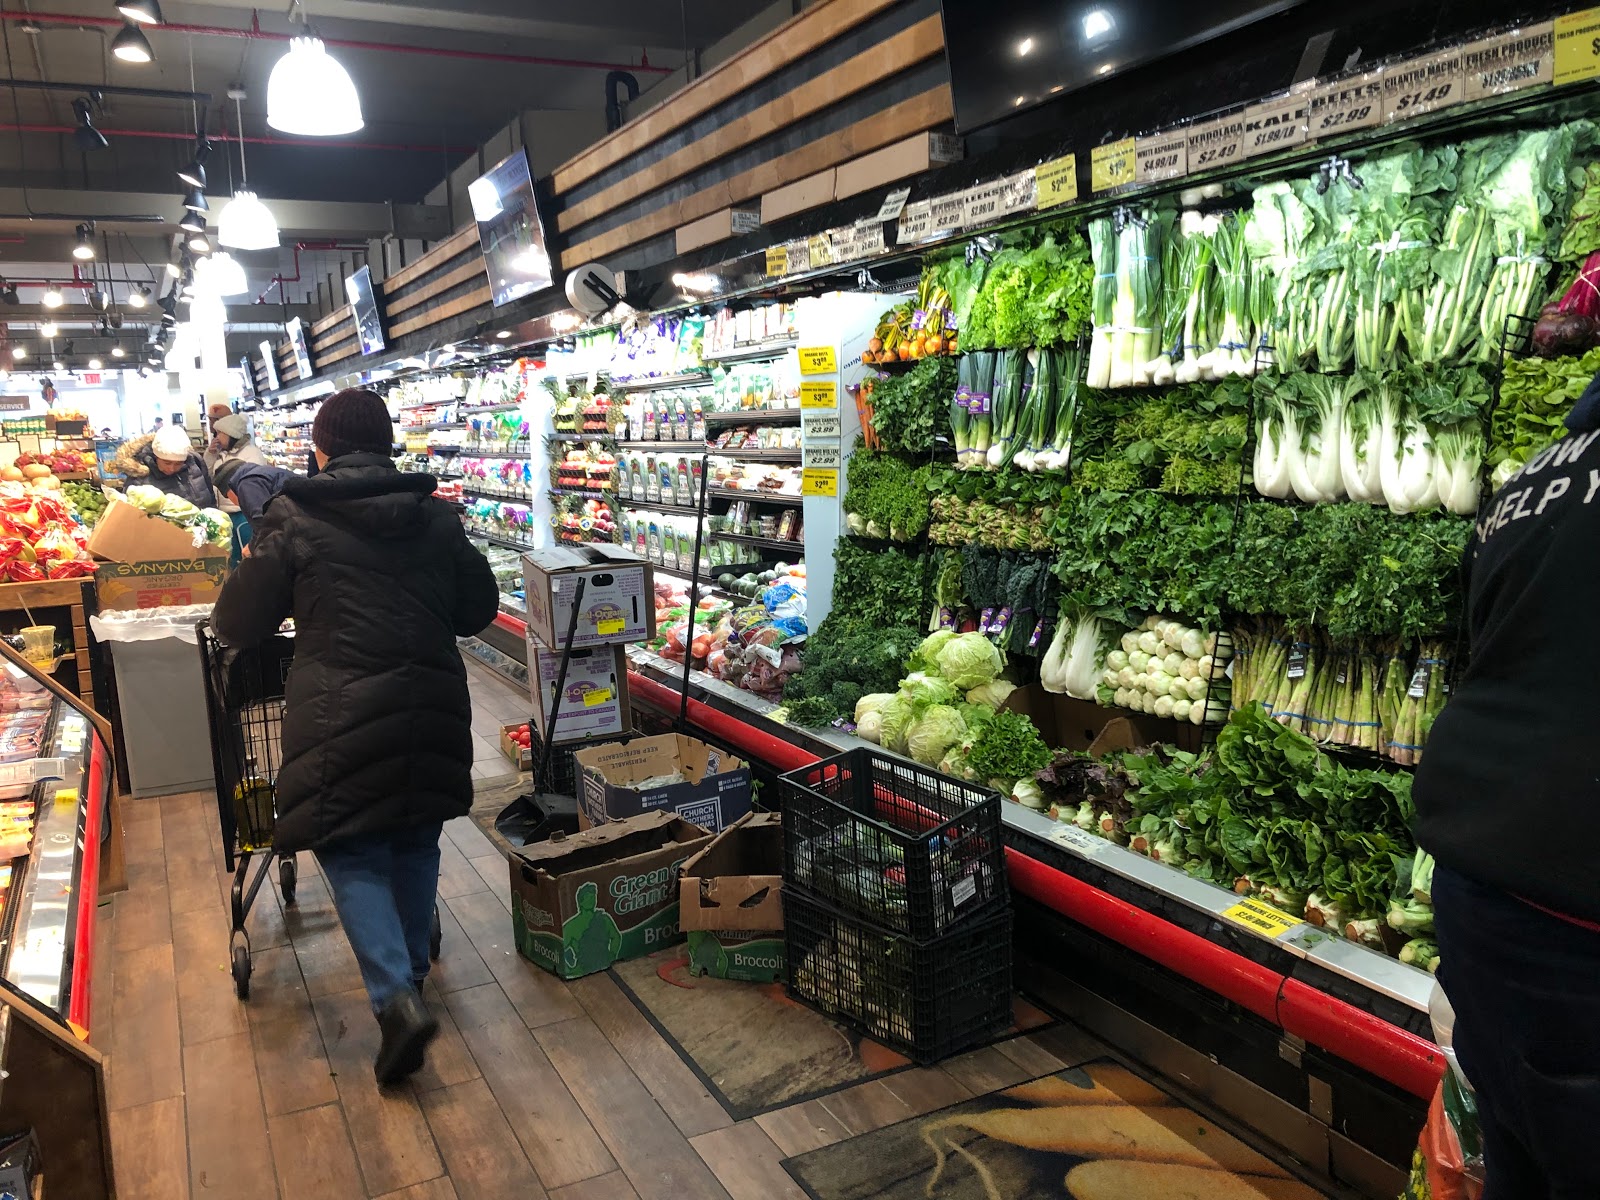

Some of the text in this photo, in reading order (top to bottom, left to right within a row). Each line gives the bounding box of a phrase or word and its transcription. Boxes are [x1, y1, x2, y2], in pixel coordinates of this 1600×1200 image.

[1384, 67, 1425, 90] CILANTRO
[1427, 58, 1459, 76] MACHO
[1311, 83, 1380, 109] BEETS
[1397, 83, 1453, 111] $1.49
[1245, 108, 1308, 133] KALE
[1320, 105, 1372, 129] $2.99
[1188, 121, 1244, 146] VERDOLAGA
[1254, 125, 1297, 147] $1.99/LB
[1137, 148, 1153, 159] WHITE
[1154, 140, 1185, 155] ASPARAGUS
[1198, 143, 1237, 165] $2.49
[1143, 153, 1179, 172] $4.99/LB
[965, 190, 999, 203] LEEKS
[900, 214, 914, 225] BOK
[936, 213, 960, 227] $3.99
[810, 426, 834, 434] $3.99
[811, 457, 835, 465] $2.99
[1482, 477, 1571, 543] HELP
[117, 560, 206, 575] BANANAS
[144, 574, 184, 582] ORGANIC
[598, 746, 659, 762] KEEP REFRIGERATED
[611, 758, 647, 769] PERISHABLE
[683, 805, 714, 818] CHURCH
[610, 867, 669, 897] Green
[614, 884, 669, 915] Giant
[1238, 900, 1295, 928] ROMAINE LETTUCE
[644, 921, 680, 944] Broc
[534, 940, 560, 964] Broccoli
[734, 953, 784, 969] Broccoli
